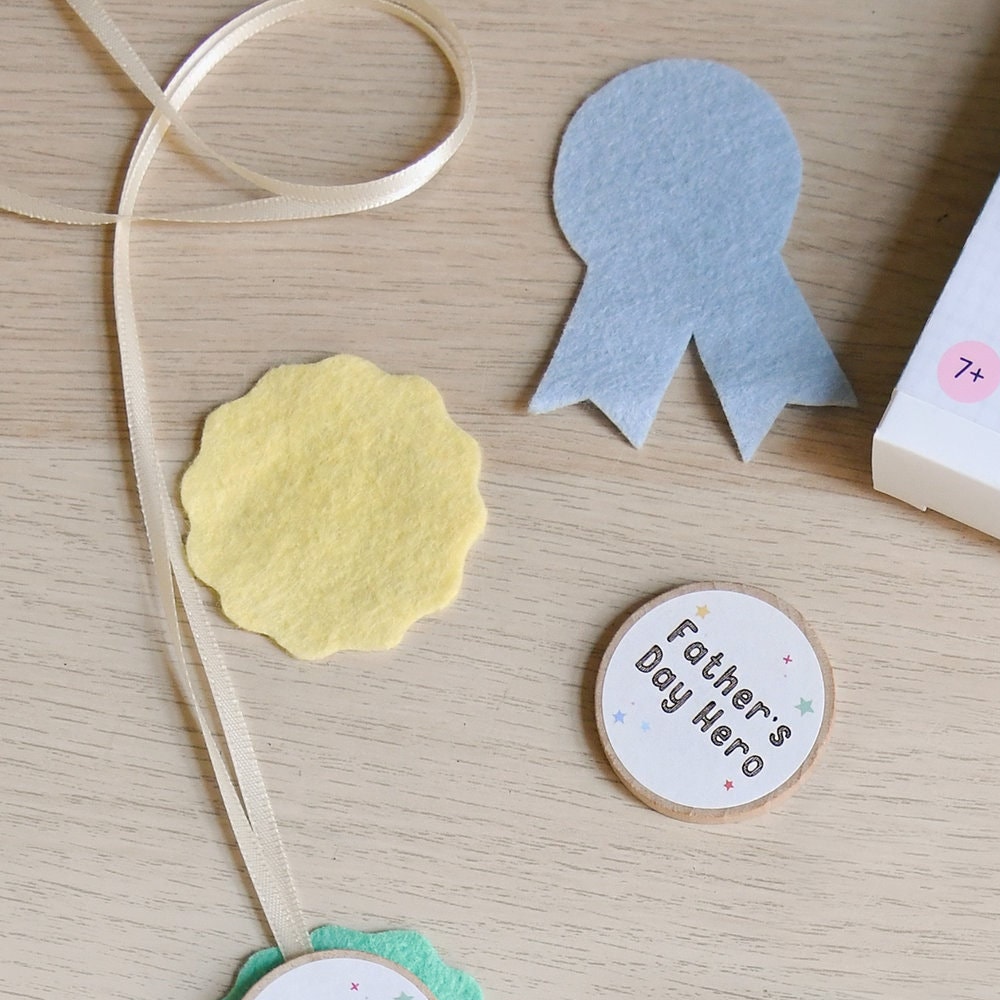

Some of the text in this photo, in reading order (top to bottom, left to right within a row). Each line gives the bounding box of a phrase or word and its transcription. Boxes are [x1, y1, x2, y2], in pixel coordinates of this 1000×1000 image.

[952, 356, 985, 383] 7+
[634, 644, 765, 778] Day Hero
[666, 618, 792, 747] Father's
